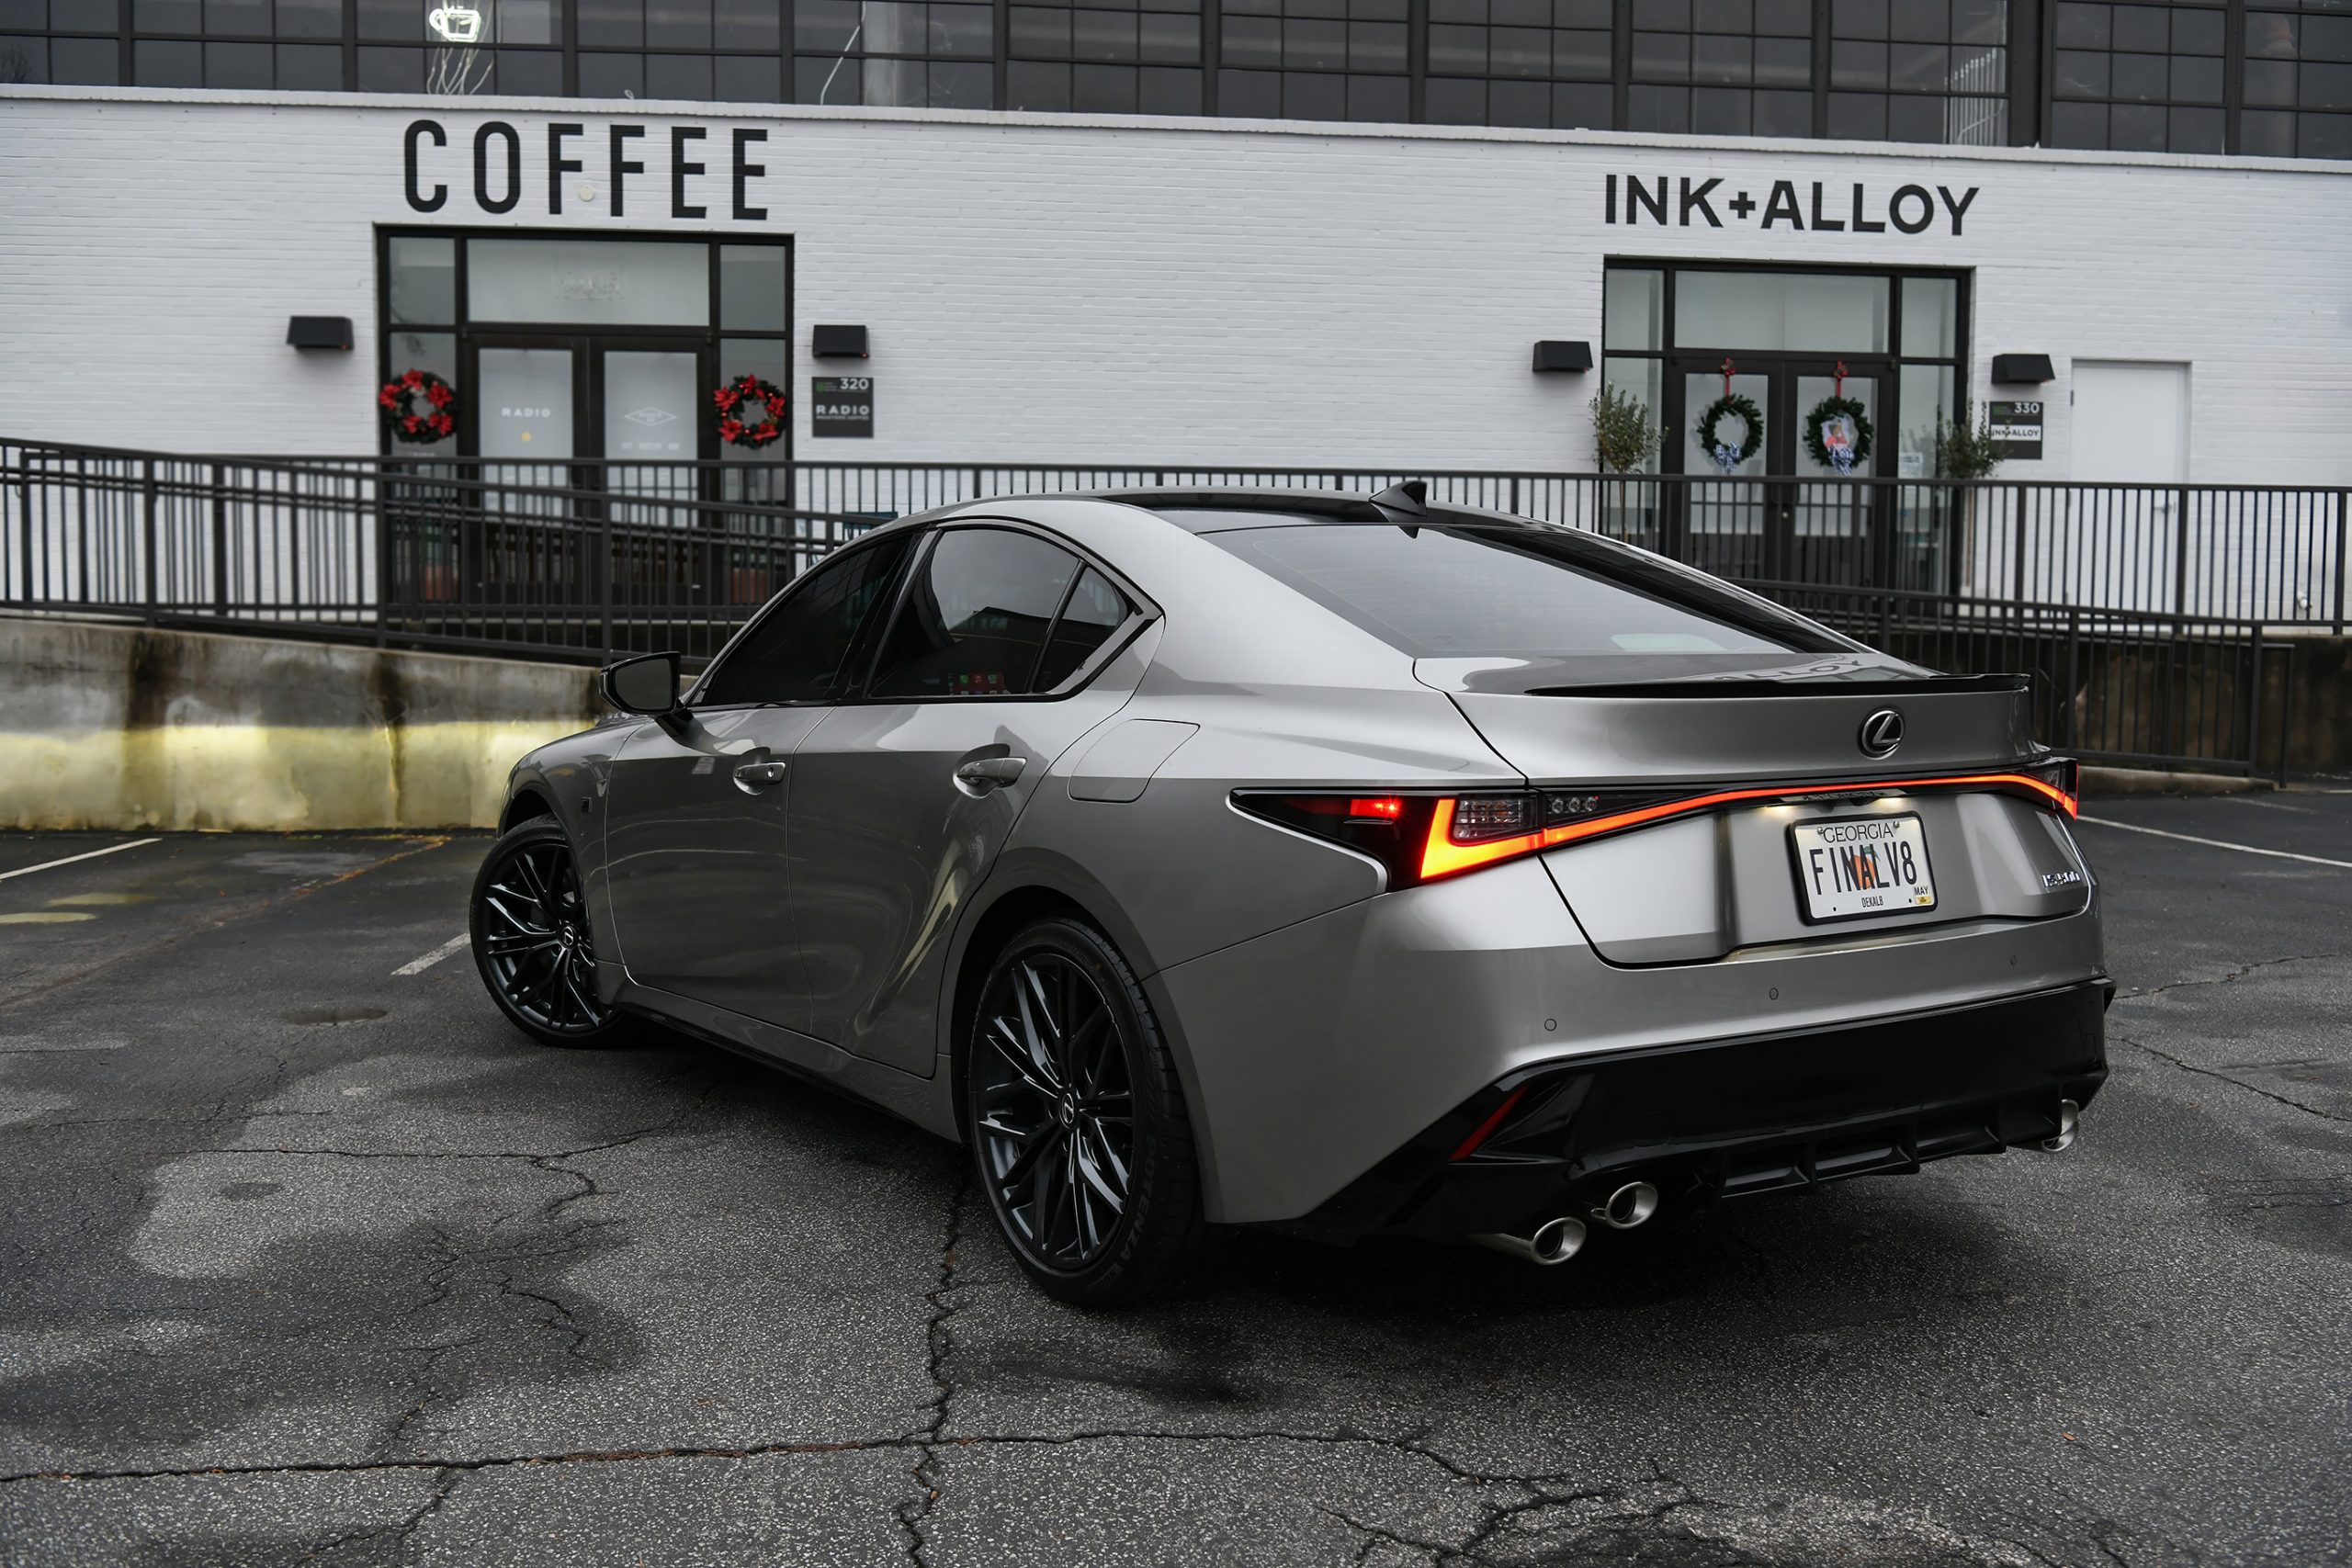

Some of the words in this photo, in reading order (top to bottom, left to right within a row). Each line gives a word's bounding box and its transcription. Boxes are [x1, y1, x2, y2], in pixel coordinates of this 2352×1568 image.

[404, 118, 768, 220] COFFEE
[1605, 174, 1980, 236] INK+ALLOY
[840, 378, 869, 390] 320
[502, 407, 551, 418] RADIO
[816, 404, 869, 415] RADIO
[2014, 402, 2040, 414] 330
[1823, 822, 1894, 843] GEORGIA
[1808, 840, 1917, 896] FINALV8
[1914, 885, 1929, 896] MAY
[1861, 896, 1884, 908] DEKALB
